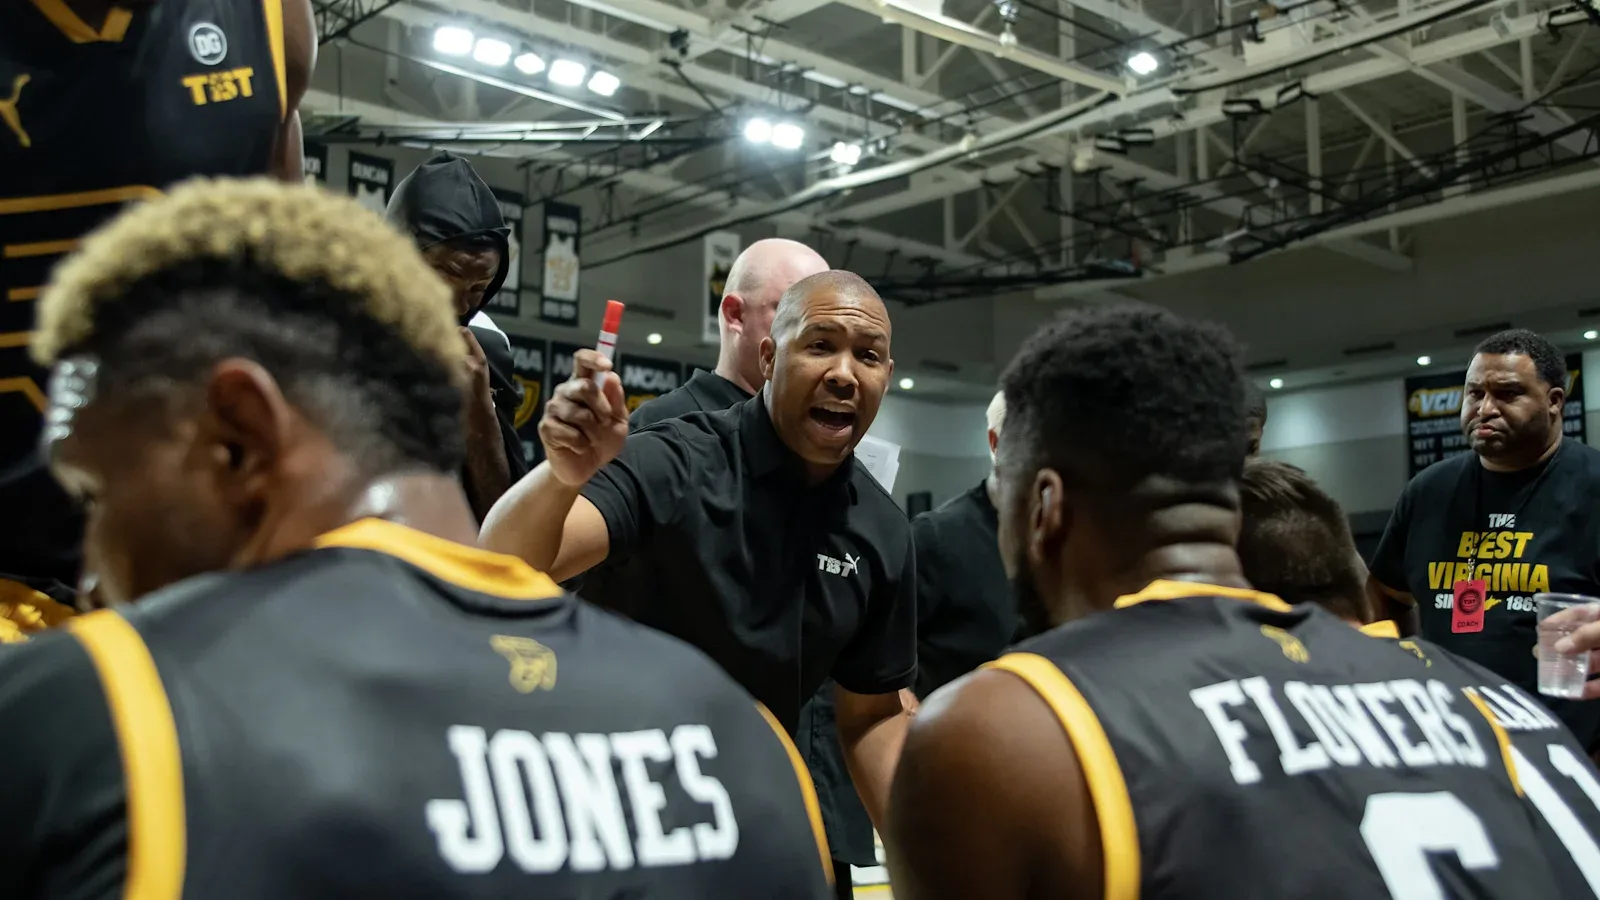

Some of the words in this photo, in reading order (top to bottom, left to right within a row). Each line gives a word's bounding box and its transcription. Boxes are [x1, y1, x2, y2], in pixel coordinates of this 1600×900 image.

[194, 33, 222, 57] DG
[181, 67, 254, 106] TBT
[622, 364, 678, 393] NCAA
[1420, 390, 1463, 415] VCU
[1488, 513, 1516, 528] THE
[1457, 531, 1534, 559] BEST
[817, 553, 853, 577] TBT
[1428, 562, 1550, 593] VIRGINIA
[1434, 593, 1454, 609] SIN
[1189, 675, 1488, 785] FLOWERS
[425, 724, 739, 874] JONES
